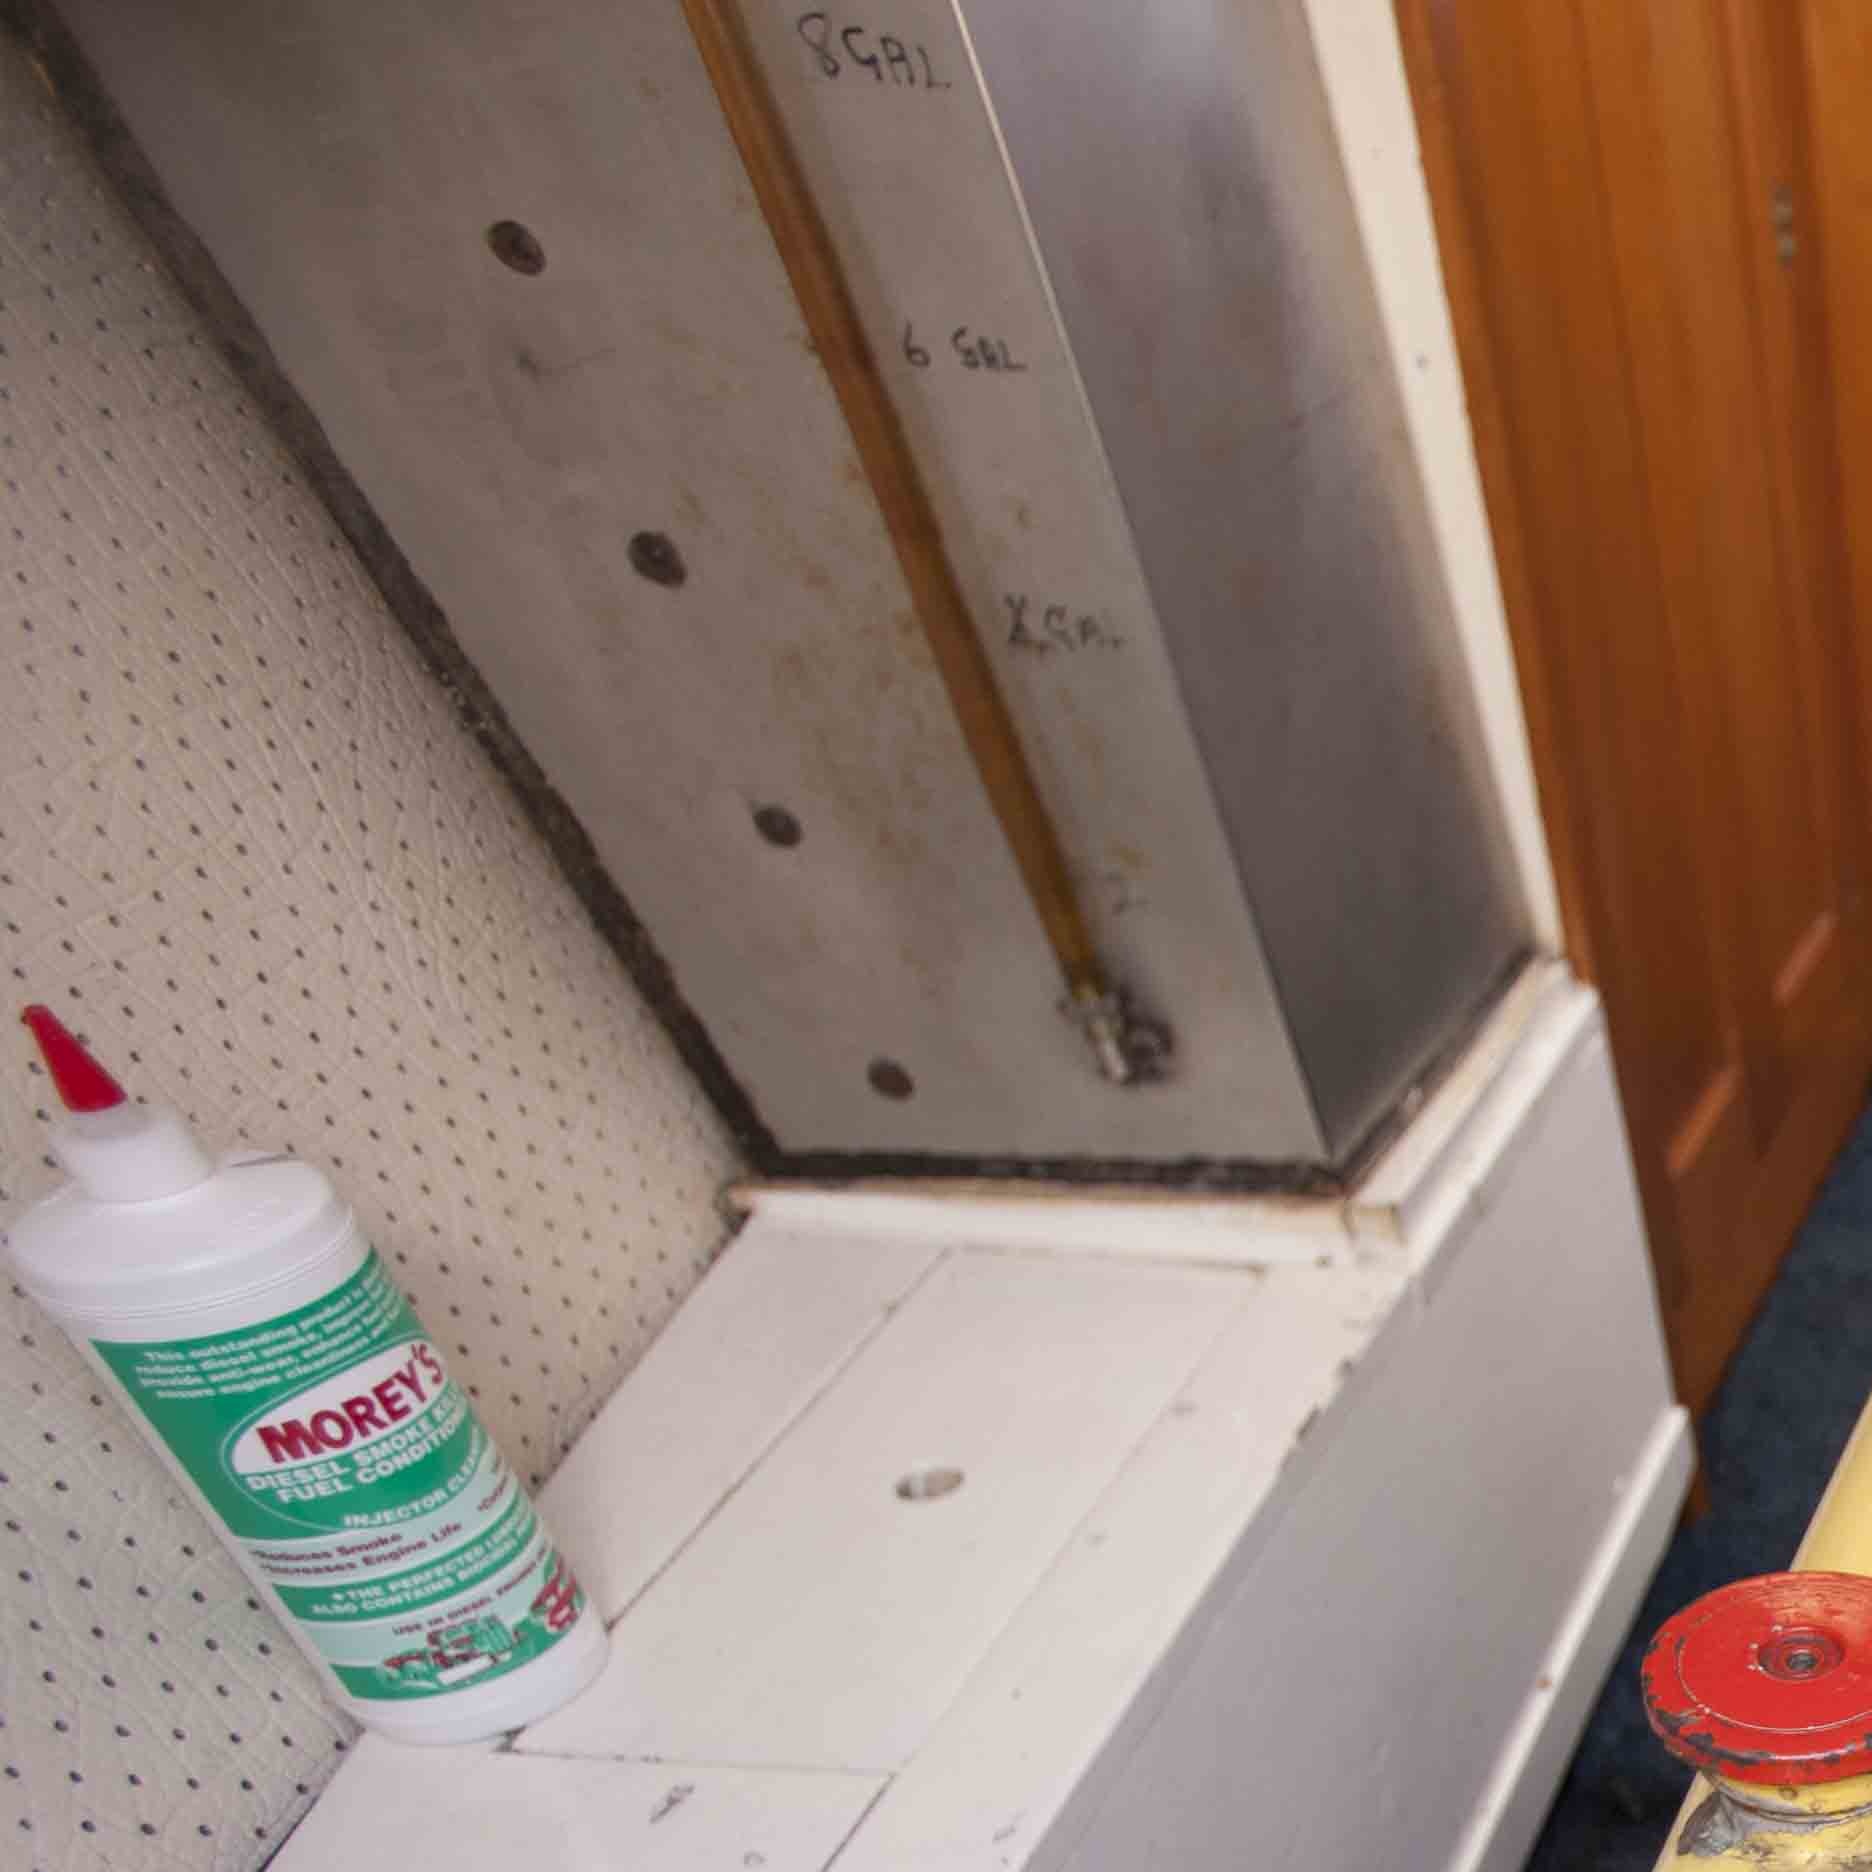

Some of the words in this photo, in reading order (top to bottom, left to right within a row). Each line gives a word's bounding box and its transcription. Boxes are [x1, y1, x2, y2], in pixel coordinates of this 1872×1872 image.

[255, 1342, 443, 1464] MOREY'S
[246, 1459, 350, 1490] DIESEL
[352, 1416, 432, 1464] SMOKE
[276, 1476, 353, 1503] FUEL
[343, 1488, 448, 1528] INJECTOR
[362, 1539, 427, 1567] Engine
